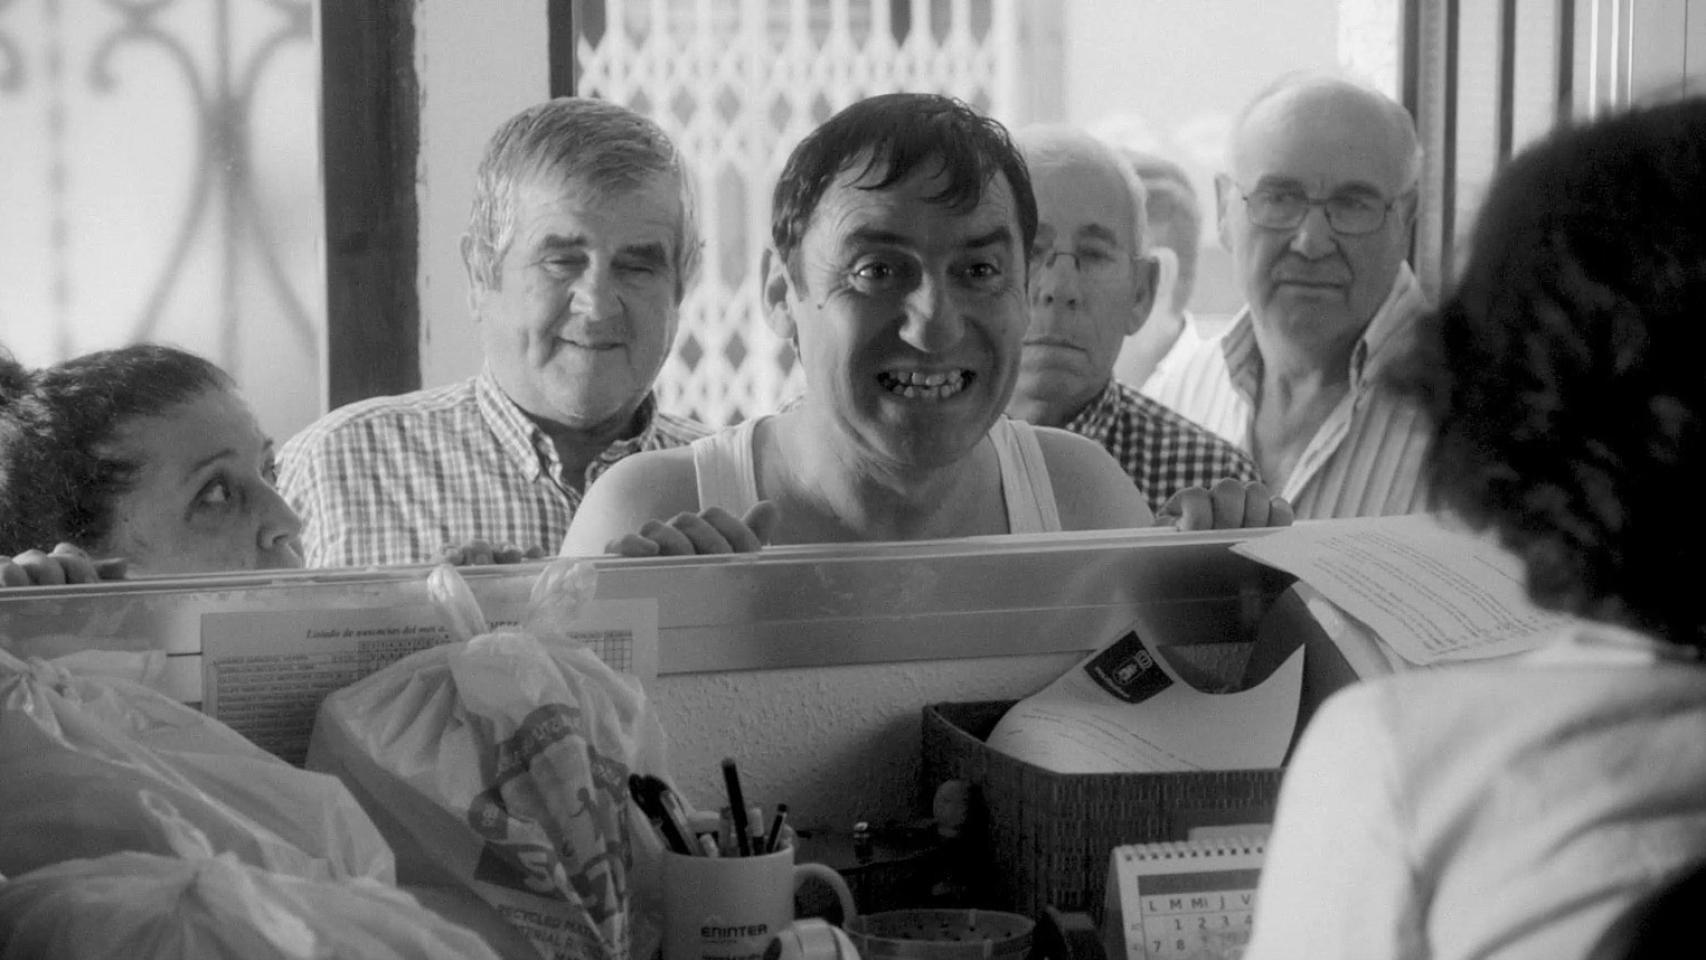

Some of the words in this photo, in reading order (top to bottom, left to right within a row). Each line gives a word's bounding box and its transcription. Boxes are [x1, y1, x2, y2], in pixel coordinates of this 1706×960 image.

[342, 627, 354, 638] de
[402, 624, 417, 635] del
[1149, 901, 1158, 912] L
[1170, 898, 1182, 911] M
[1220, 896, 1225, 911] J
[1241, 894, 1251, 905] V
[1174, 919, 1182, 930] 1
[1198, 917, 1206, 930] 2
[1222, 916, 1229, 927] 3
[1244, 914, 1252, 925] 4
[700, 924, 768, 938] ENINTER
[1152, 940, 1161, 952] 7
[1176, 939, 1185, 951] 8
